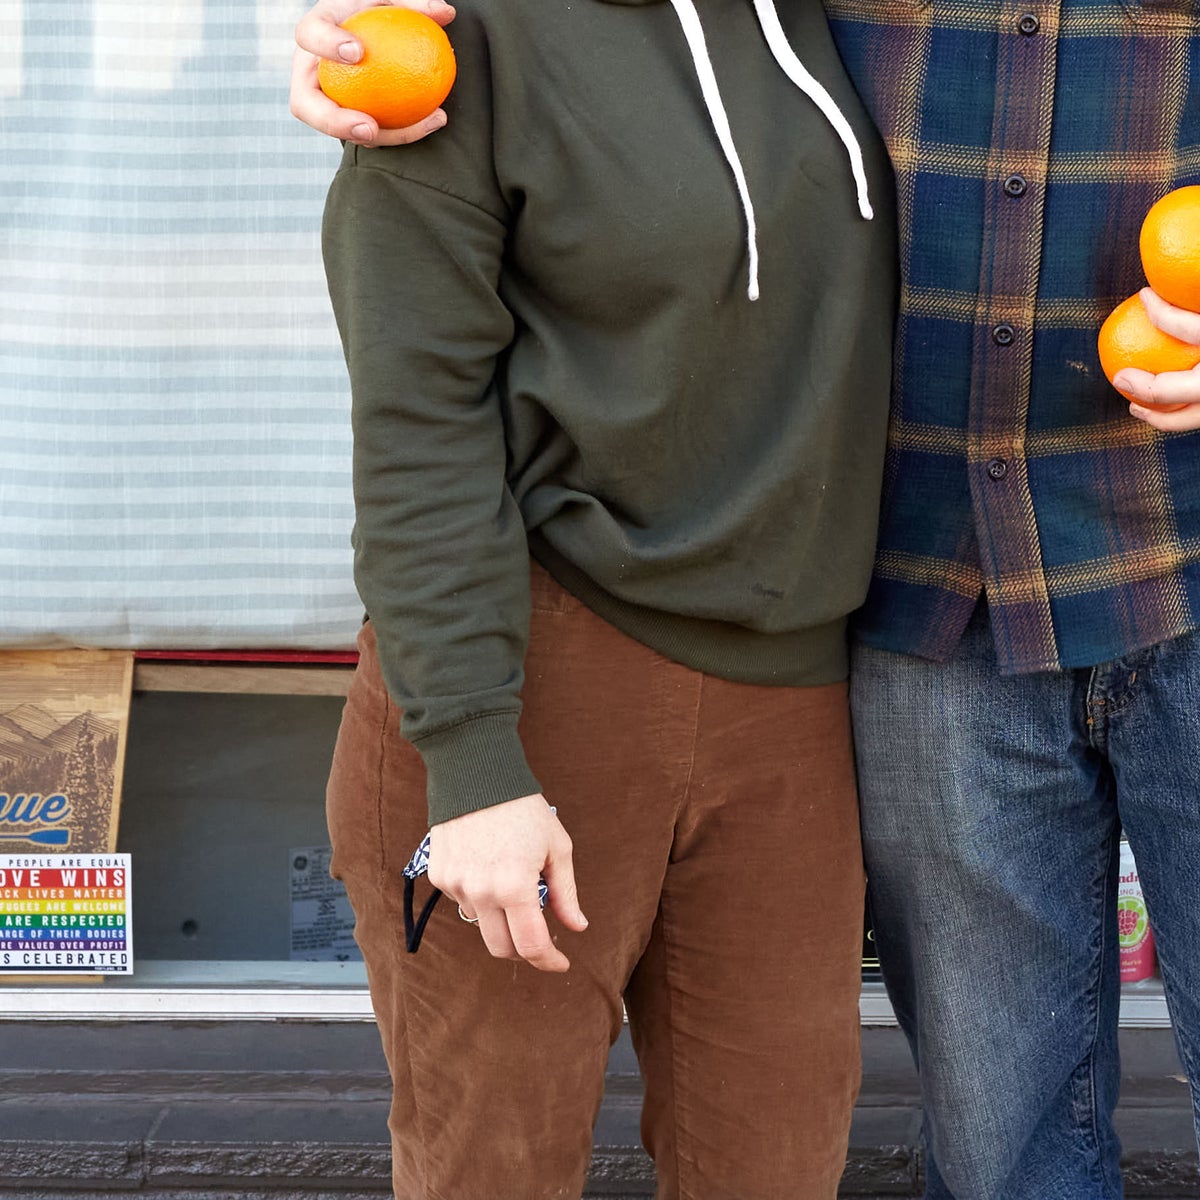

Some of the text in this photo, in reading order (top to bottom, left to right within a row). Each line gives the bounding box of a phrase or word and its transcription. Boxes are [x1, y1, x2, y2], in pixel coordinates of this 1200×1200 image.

[9, 859, 126, 867] PEOPLE ARE EQUAL
[61, 869, 124, 887] WINS
[28, 889, 65, 899] LIVES
[74, 889, 123, 898] MATTER
[46, 902, 67, 912] ARE
[73, 902, 125, 912] WELCOME
[5, 915, 124, 926] ARE RESPECTED
[31, 929, 43, 938] OF
[50, 929, 81, 938] THEIR
[87, 929, 125, 938] BODIES
[18, 941, 55, 950] VALUED
[60, 941, 84, 950] OVER
[90, 941, 124, 950] PROFIT
[23, 953, 128, 965] CELEBRATED
